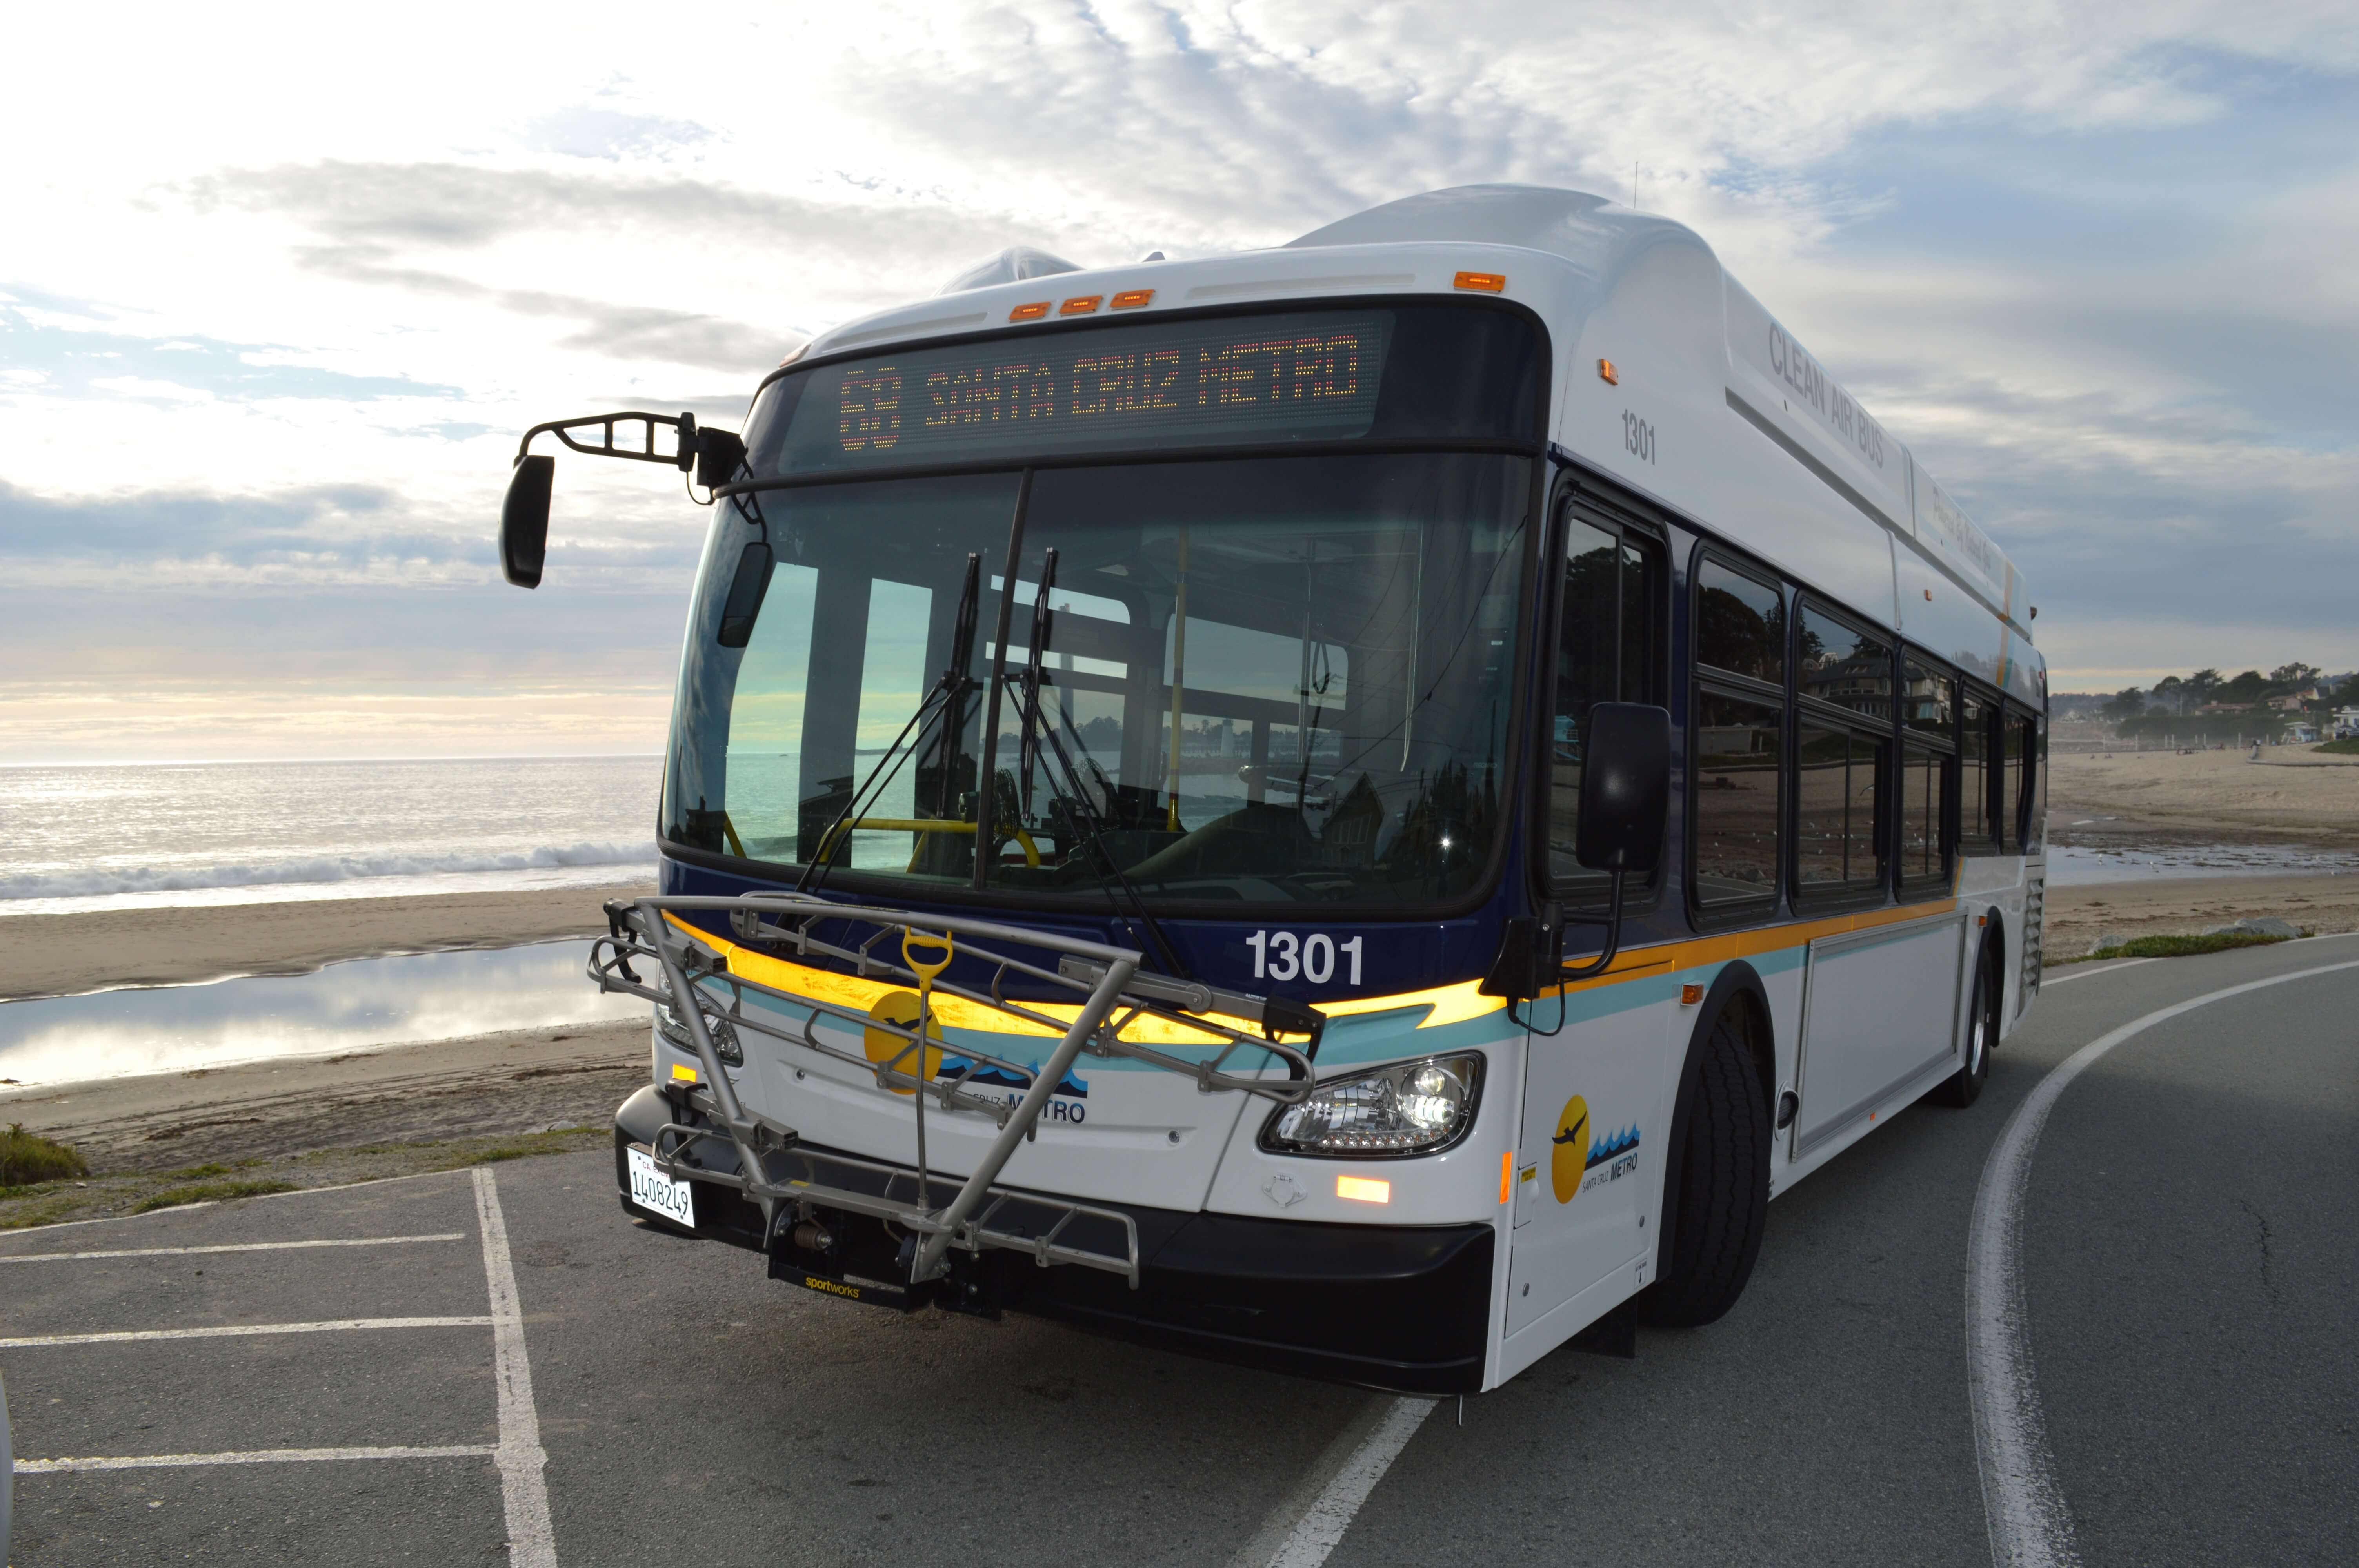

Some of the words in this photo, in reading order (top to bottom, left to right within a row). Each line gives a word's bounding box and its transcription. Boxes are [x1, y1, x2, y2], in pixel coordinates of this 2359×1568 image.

[926, 363, 1054, 425] SANTA
[1072, 350, 1179, 414] CRUZ
[1199, 335, 1358, 404] METRO
[1769, 321, 1825, 415] CLEAN
[1832, 384, 1853, 441] AIR
[1857, 408, 1884, 468] BUS
[1622, 408, 1655, 466] 1301
[1246, 930, 1362, 985] 1301
[1007, 1093, 1085, 1124] MTRO
[643, 1161, 651, 1171] CA
[1583, 1177, 1596, 1193] SANTA
[1597, 1171, 1609, 1186] CRUZ
[1610, 1152, 1637, 1181] METRO
[633, 1171, 688, 1215] 1408249
[806, 1277, 859, 1298] sportworks
